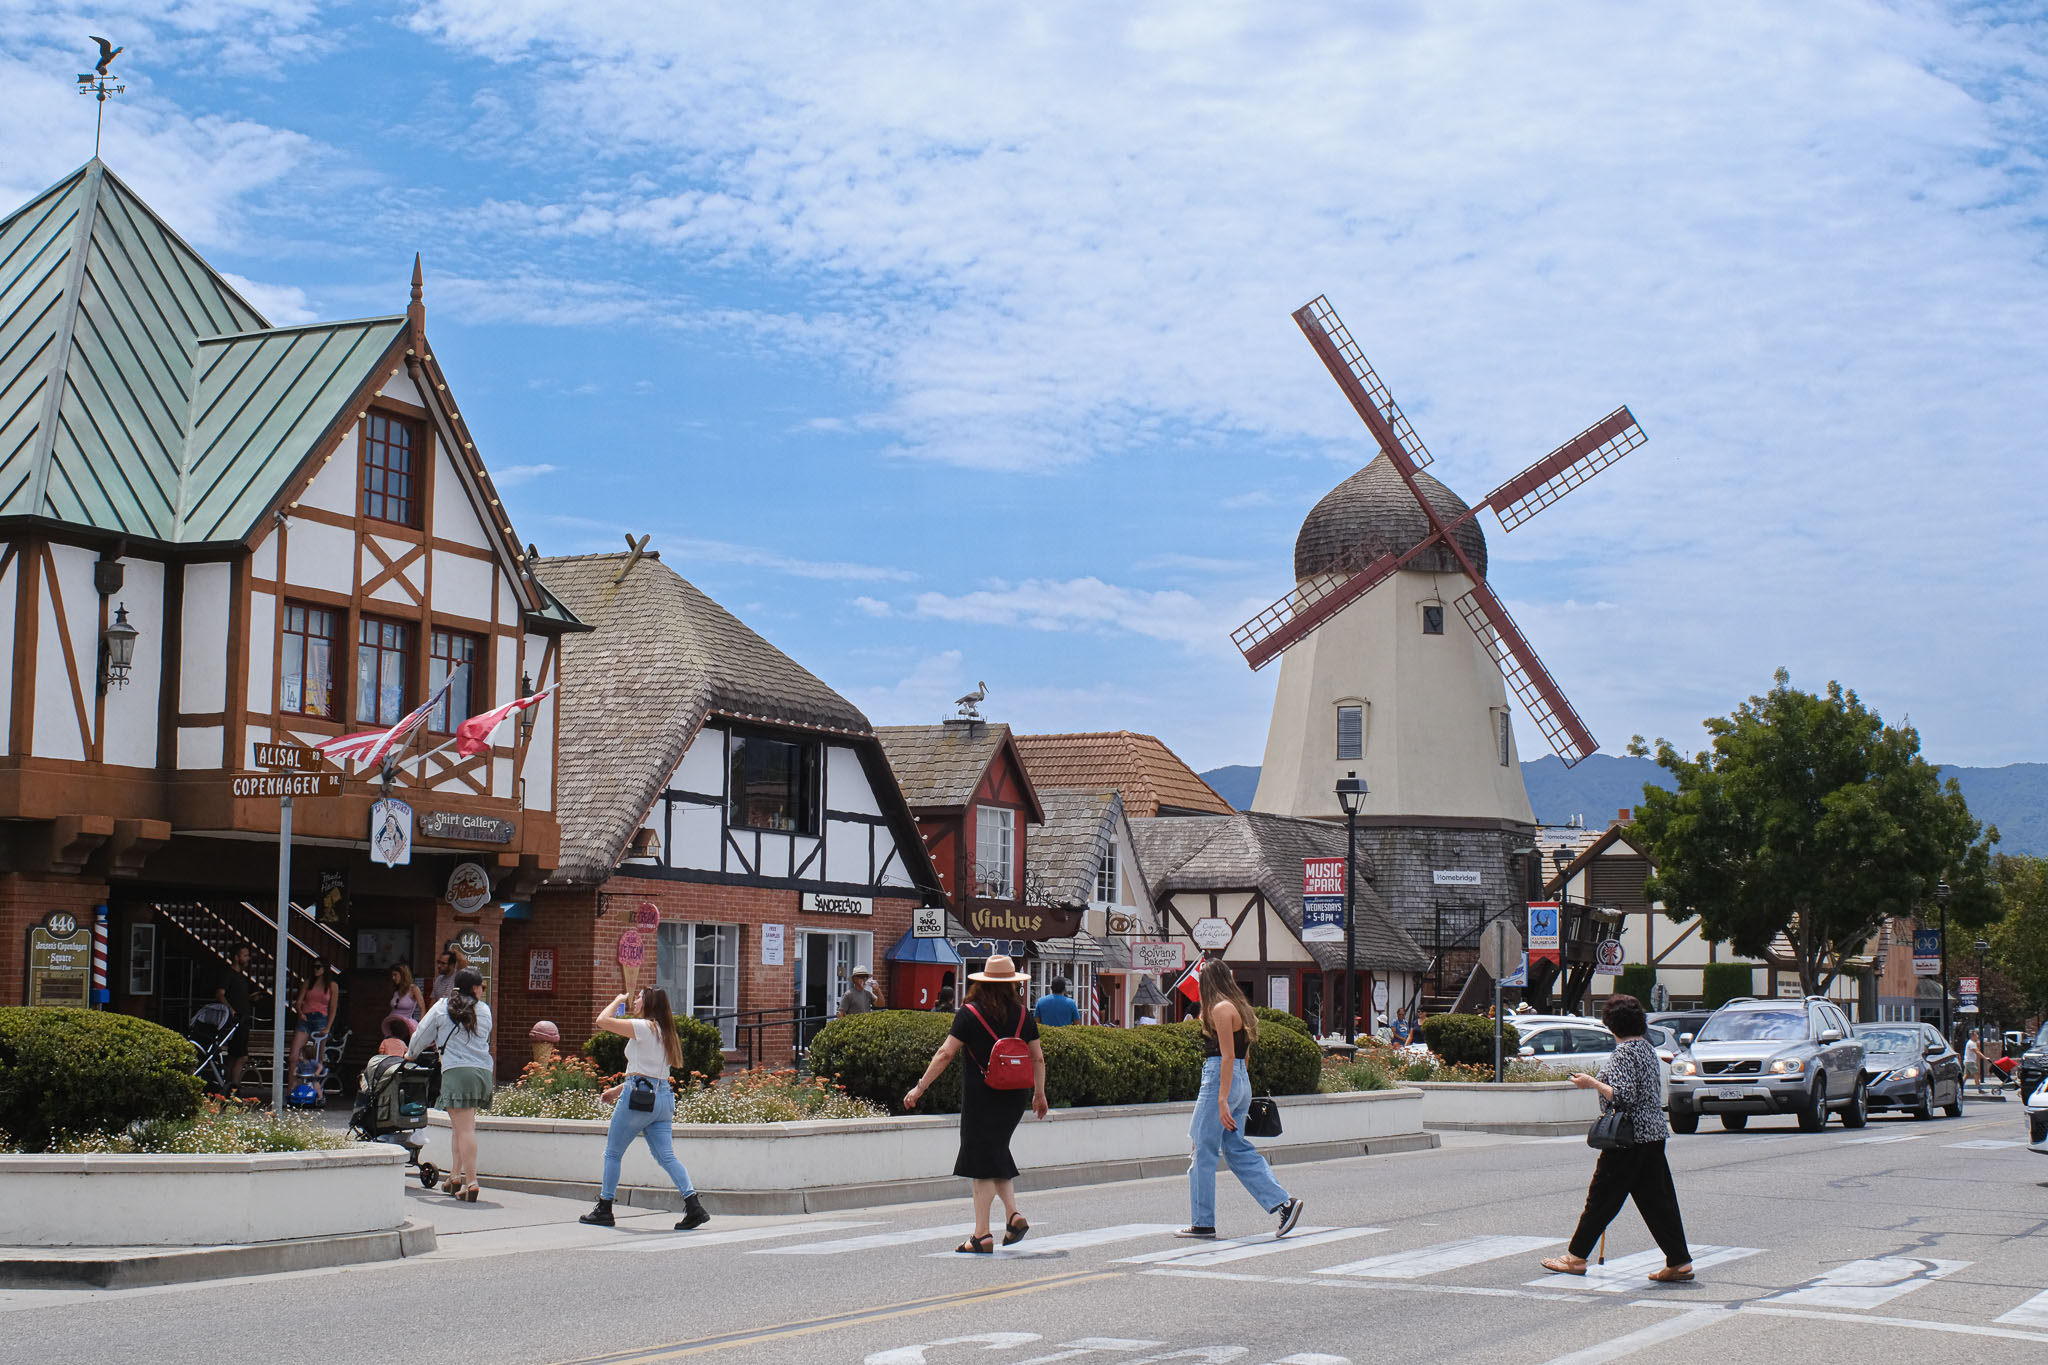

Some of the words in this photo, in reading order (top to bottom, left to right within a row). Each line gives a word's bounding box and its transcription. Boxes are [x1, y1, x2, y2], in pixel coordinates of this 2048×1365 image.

[260, 747, 301, 768] ALISAL
[312, 751, 322, 761] RD.
[233, 777, 320, 796] COPENHAGEN
[329, 775, 340, 785] DR.
[434, 813, 460, 831] Shirt
[462, 816, 500, 833] Gallery
[1305, 863, 1342, 878] MUSIC
[1314, 878, 1341, 892] PARK
[1436, 874, 1477, 882] Homebridge
[1305, 903, 1342, 912] WEDNESDAYS
[49, 915, 75, 932] 446
[919, 916, 937, 925] SANO
[971, 908, 1043, 932] Vinhus
[57, 942, 88, 952] Copenhagen
[461, 934, 480, 948] 446
[50, 952, 72, 963] Square
[531, 951, 554, 960] FREE
[1139, 946, 1177, 961] Solvang
[1144, 957, 1172, 967] Bakery
[530, 980, 553, 989] FREE
